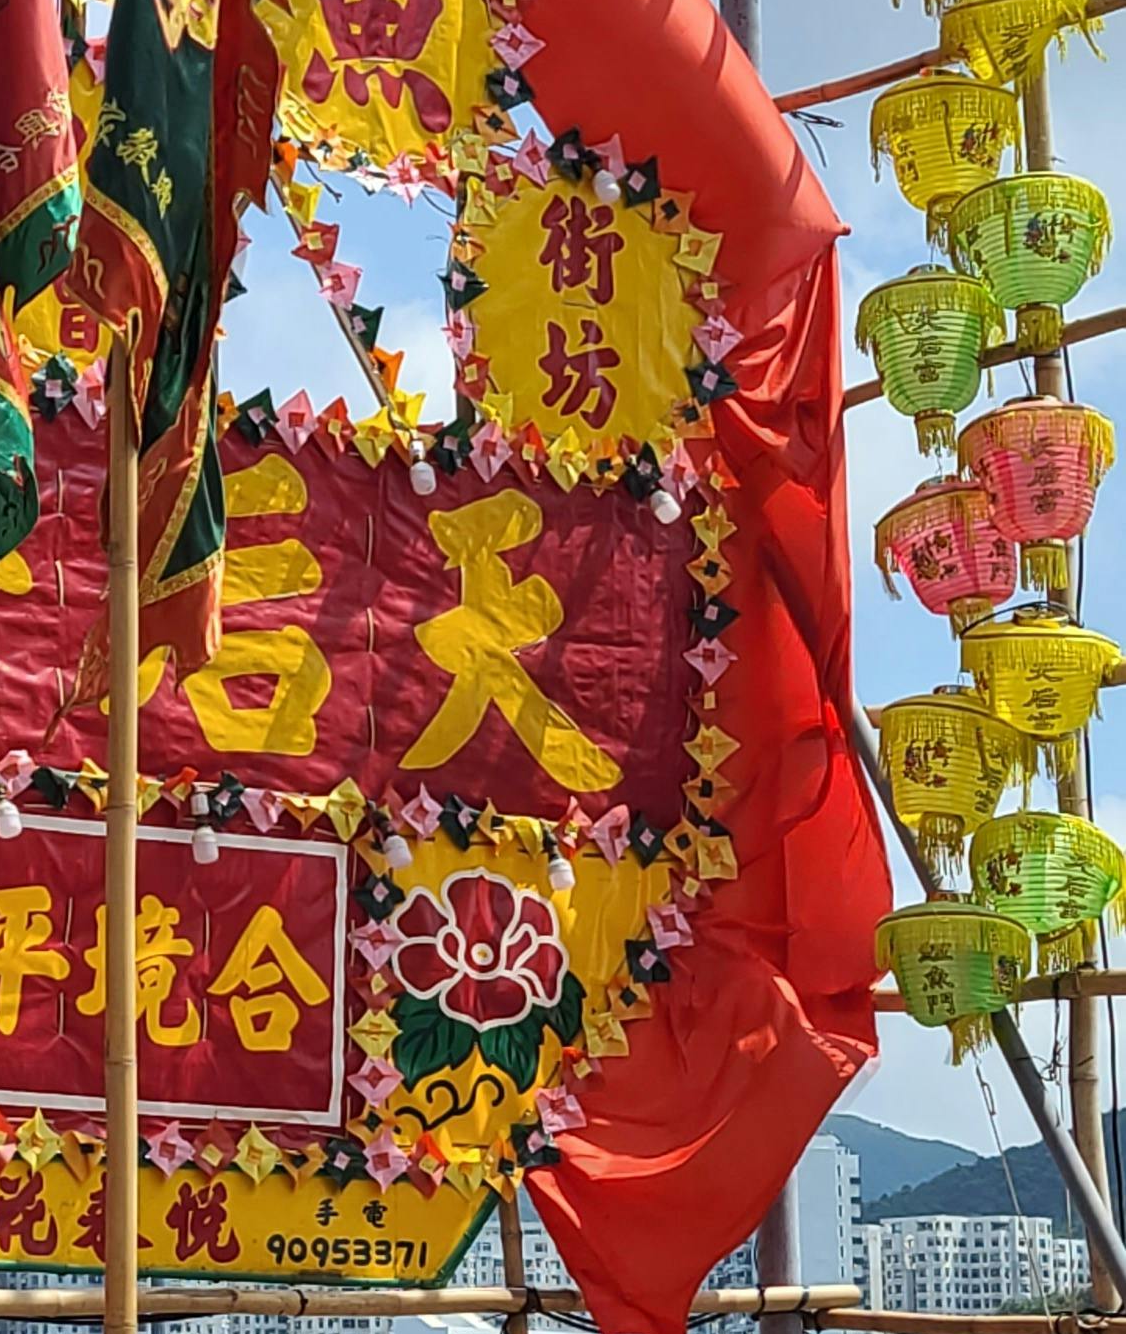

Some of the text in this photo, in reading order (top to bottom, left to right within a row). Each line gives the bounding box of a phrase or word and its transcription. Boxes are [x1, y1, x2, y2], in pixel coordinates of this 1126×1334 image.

[539, 194, 624, 430] 街坊
[1022, 662, 1064, 731] 天后宮
[266, 1233, 428, 1269] 90953371
